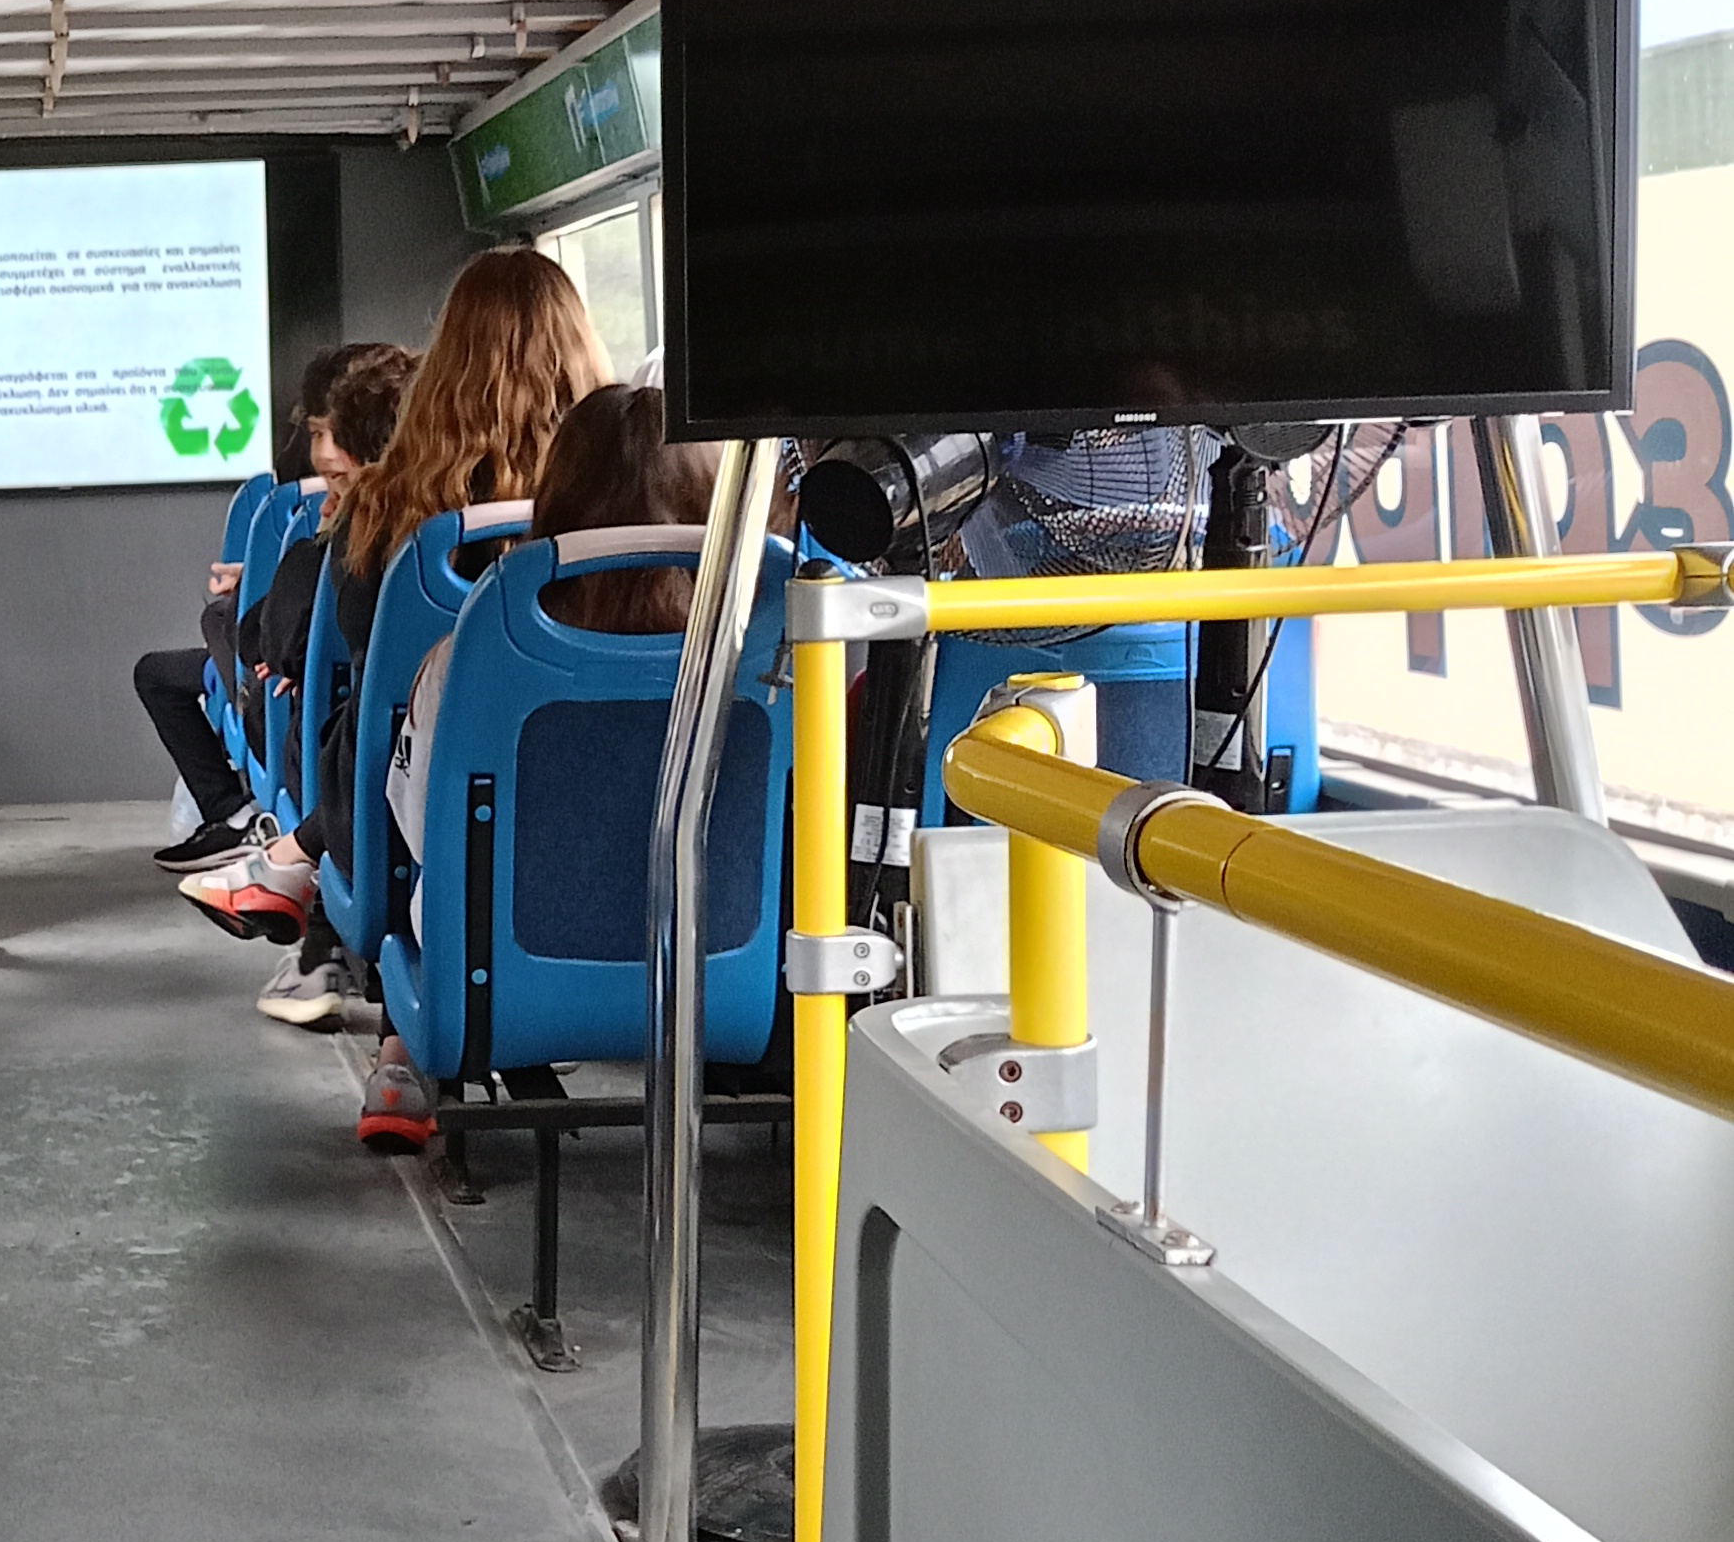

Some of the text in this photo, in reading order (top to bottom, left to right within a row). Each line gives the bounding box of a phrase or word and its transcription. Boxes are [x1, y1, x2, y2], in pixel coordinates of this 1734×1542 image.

[66, 251, 80, 260] σε
[86, 246, 160, 260] συσκευασίες
[166, 246, 184, 256] και
[189, 242, 241, 256] σημαίνει
[0, 267, 64, 280] συμμετέχει
[73, 267, 86, 277] σε
[94, 264, 146, 277] σύστημα
[49, 281, 114, 295] οικονομικά
[121, 281, 139, 294] για
[143, 280, 163, 292] την
[166, 276, 241, 290] ανακύκλωση
[75, 368, 97, 380] στα
[48, 386, 69, 398] Δεν
[74, 383, 126, 398] σημαίνει
[1114, 412, 1157, 423] SAMSUNG
